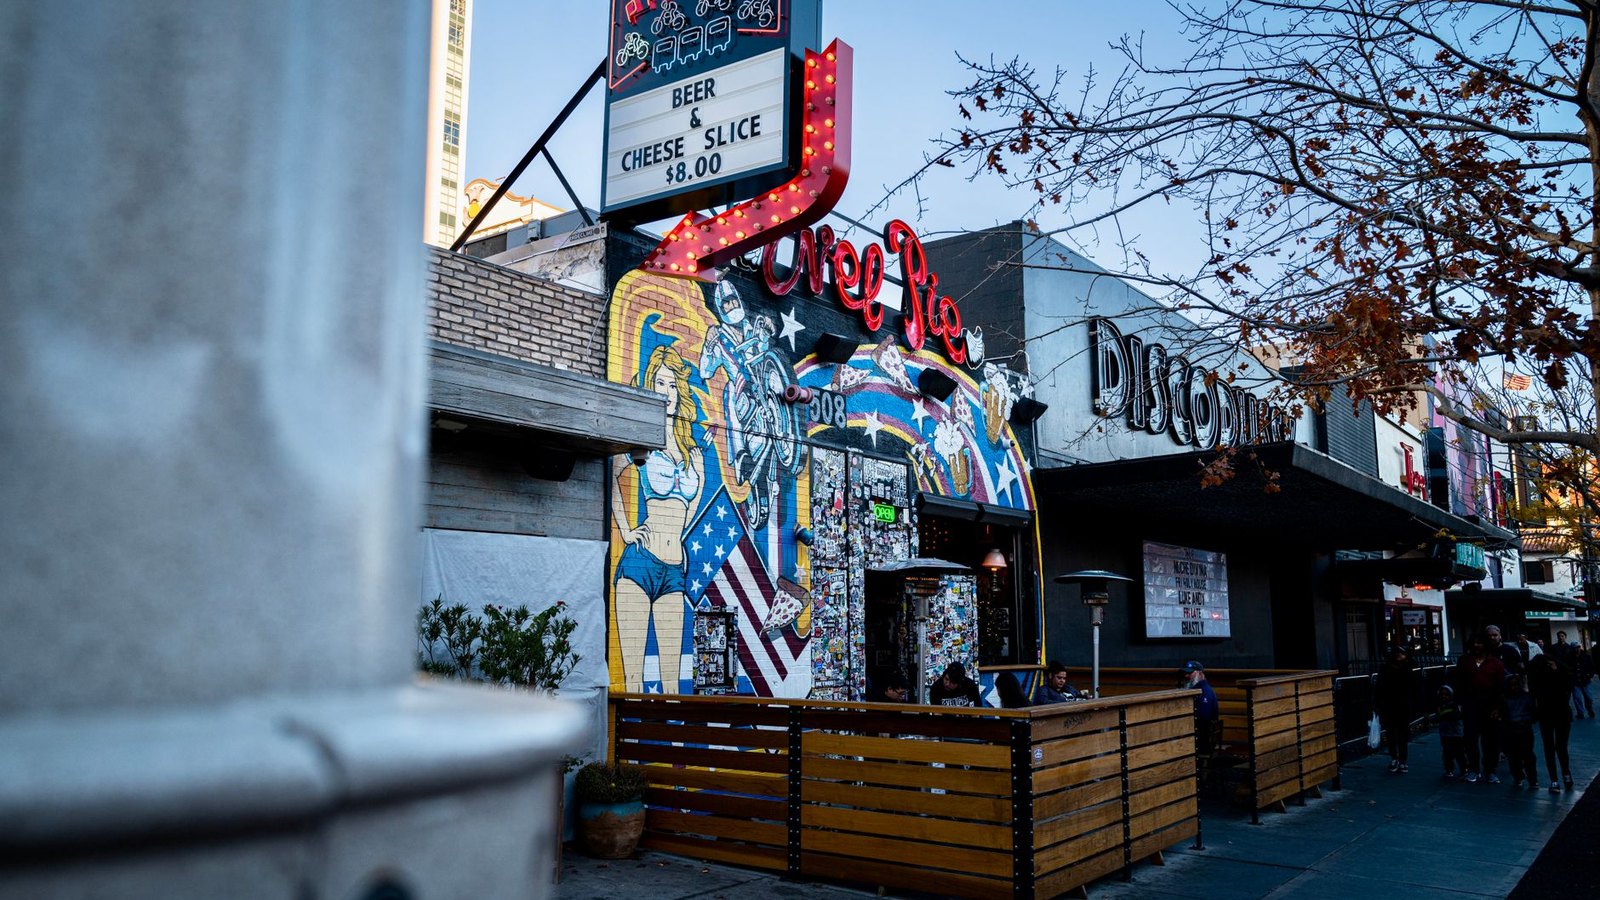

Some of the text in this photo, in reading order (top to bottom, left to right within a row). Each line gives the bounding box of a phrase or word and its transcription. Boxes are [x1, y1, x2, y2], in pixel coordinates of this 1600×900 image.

[672, 78, 716, 109] BEER
[689, 107, 701, 129] &
[621, 115, 761, 172] CHEESE SLICE
[666, 152, 722, 185] $8.00
[883, 218, 967, 365] Pie
[810, 388, 846, 429] 508
[875, 506, 895, 519] OPEN
[1181, 621, 1205, 635] GHASTLY
[1190, 608, 1201, 619] LATE
